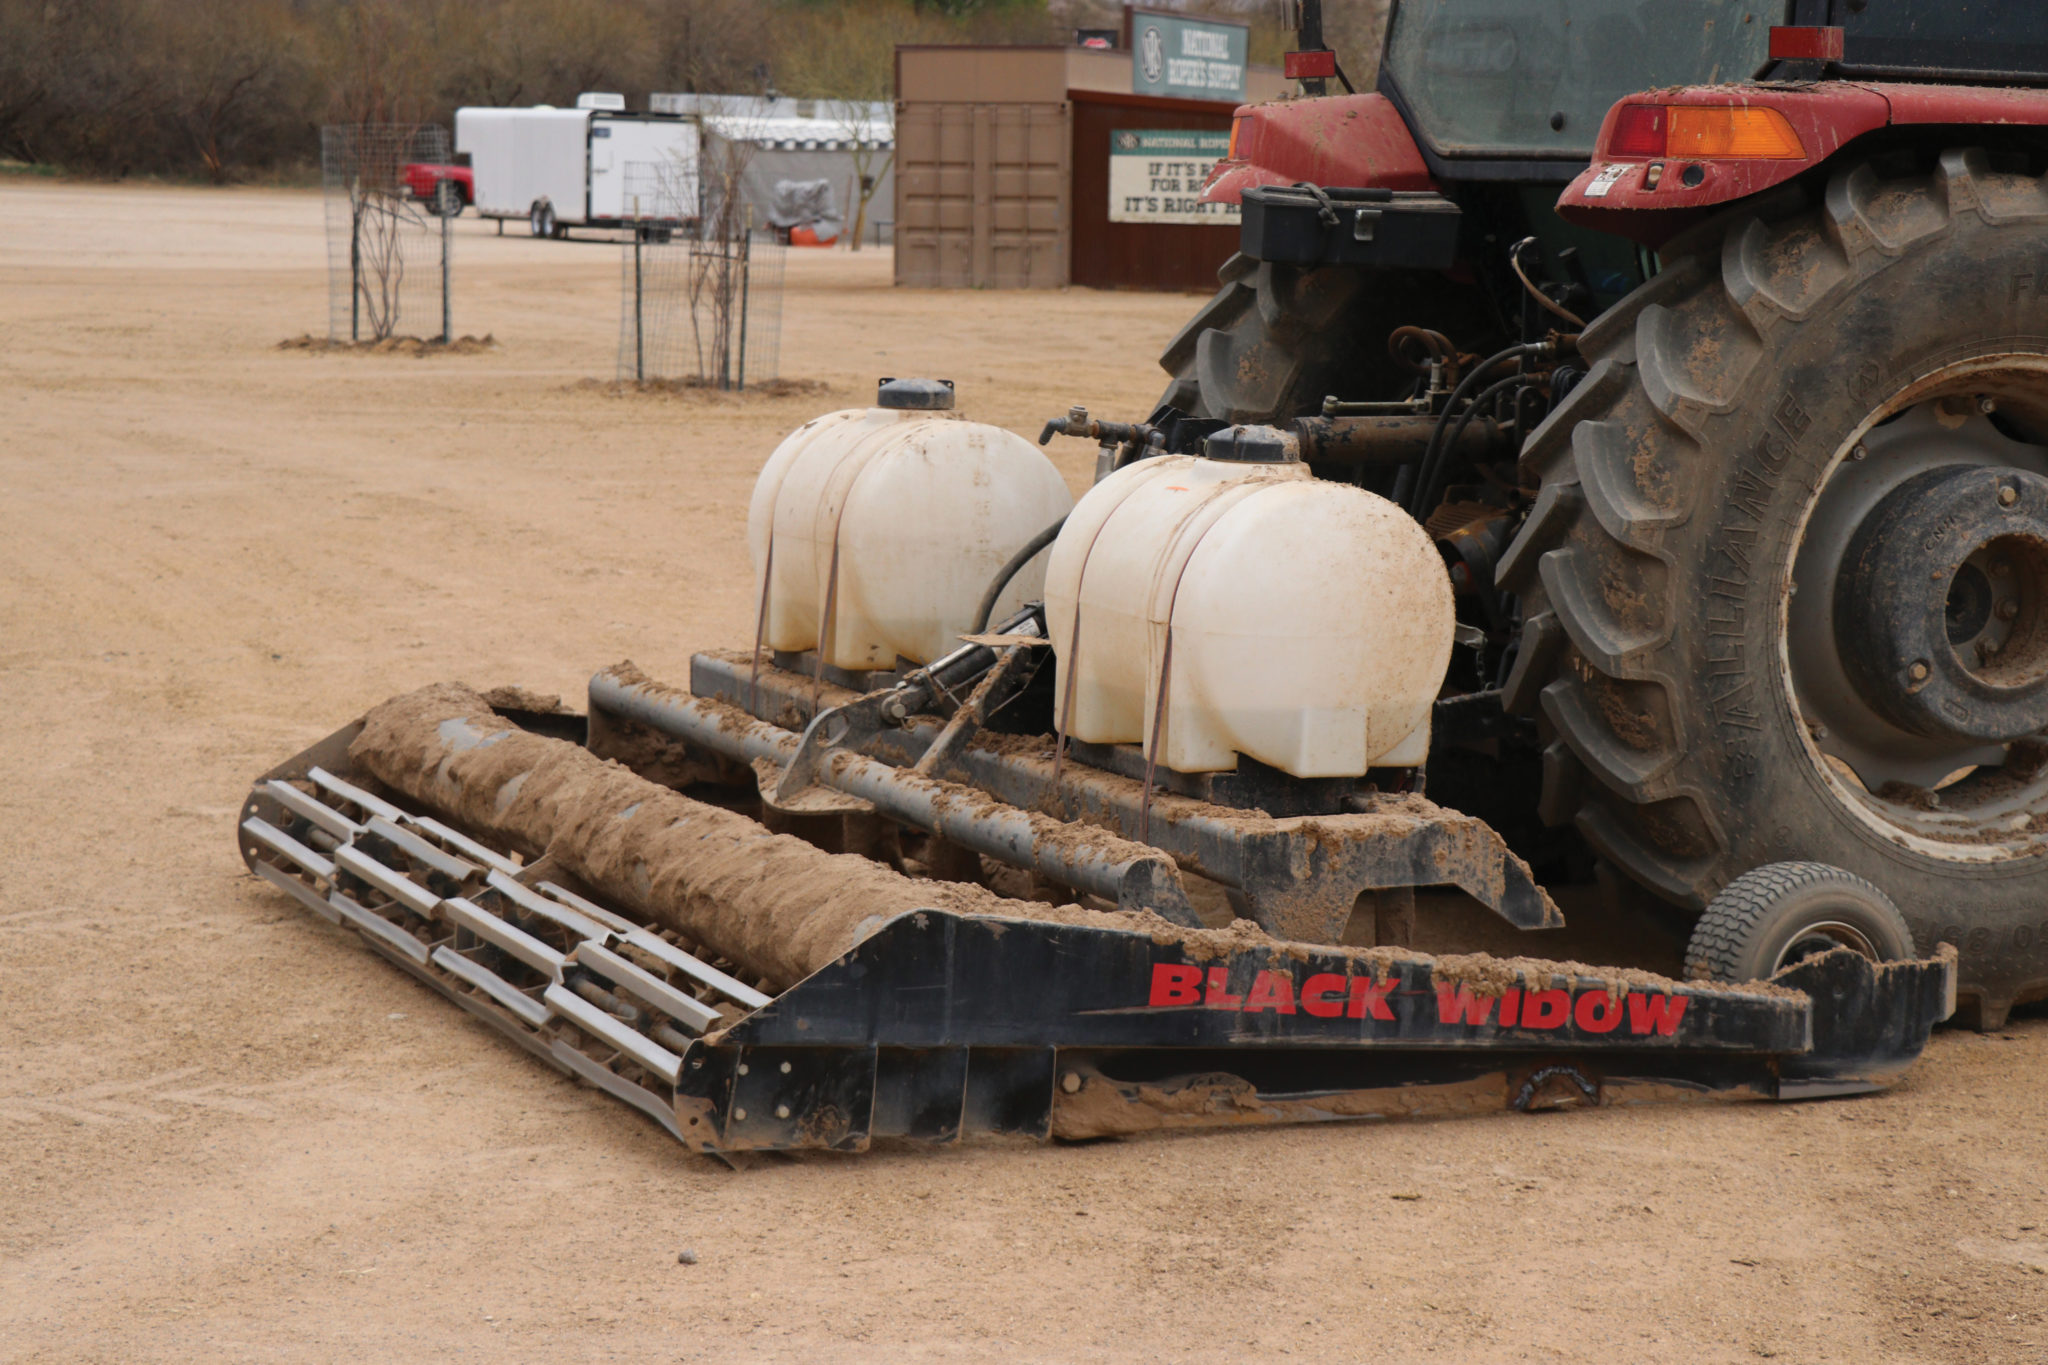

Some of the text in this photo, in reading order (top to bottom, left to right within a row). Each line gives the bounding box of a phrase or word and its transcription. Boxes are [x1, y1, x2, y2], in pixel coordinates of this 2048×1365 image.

[1182, 29, 1229, 60] NATIONAL
[1207, 62, 1242, 91] SUPPLY
[1142, 138, 1196, 149] NATIONAL
[1149, 163, 1163, 176] IF
[1167, 163, 1197, 176] IT'S
[1151, 179, 1181, 192] FOR
[1125, 197, 1159, 213] IT'S
[1149, 962, 1690, 1037] BLACK WIDOW
